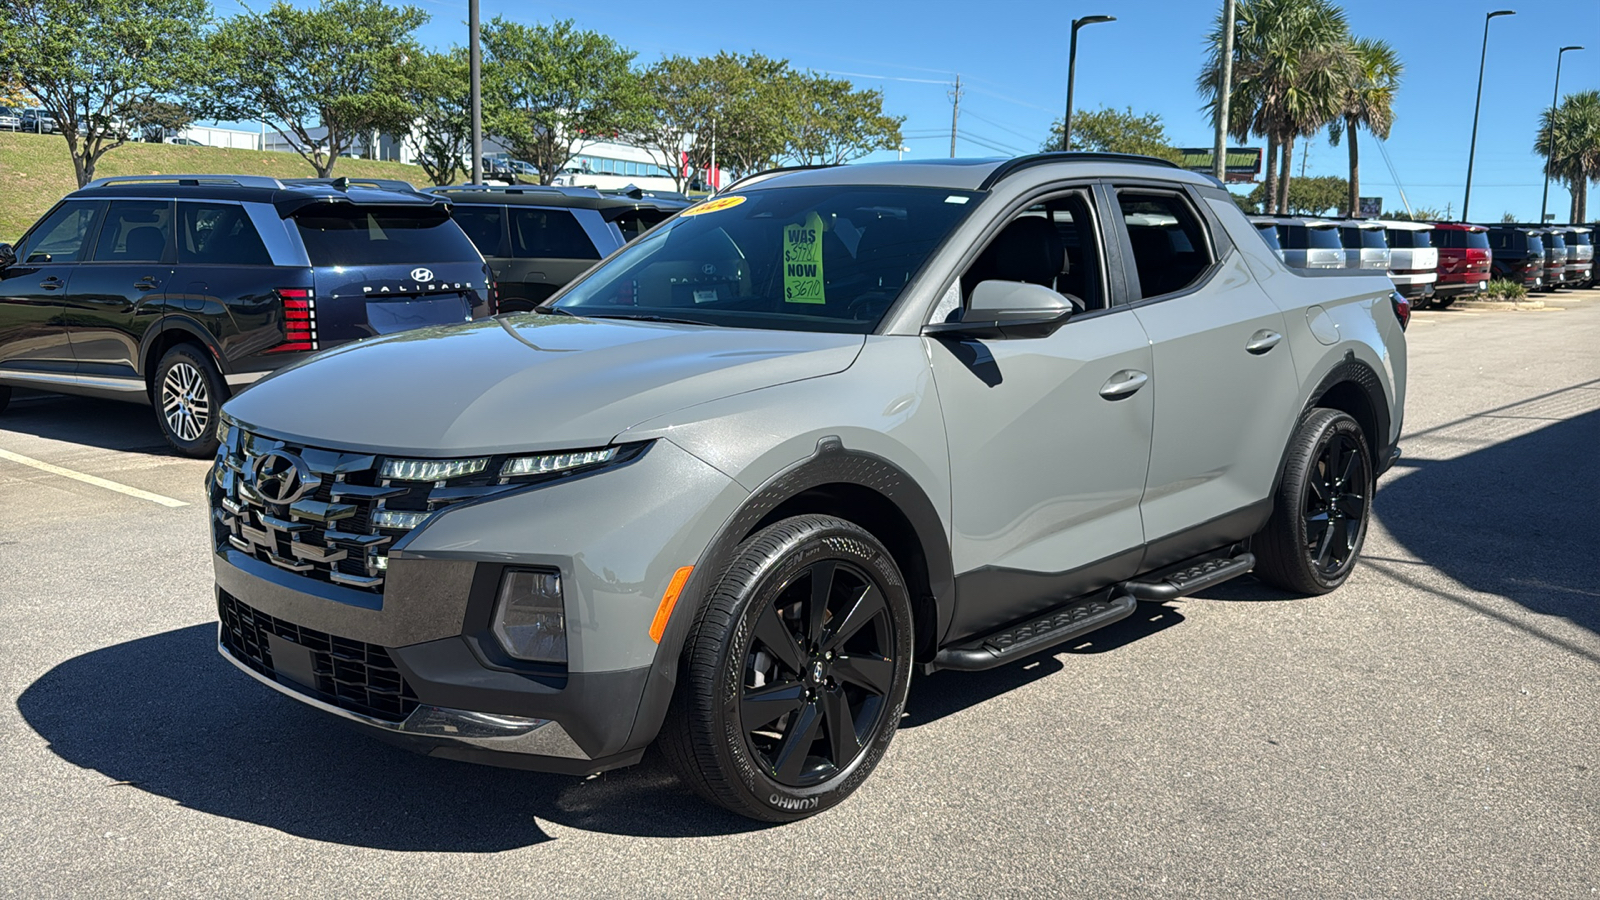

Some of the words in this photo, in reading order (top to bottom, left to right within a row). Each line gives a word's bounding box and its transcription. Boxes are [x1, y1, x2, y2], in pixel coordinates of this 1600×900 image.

[788, 230, 816, 243] WAS
[788, 264, 817, 277] NOW
[363, 282, 472, 293] PALISADE
[769, 793, 819, 810] KUMHO
